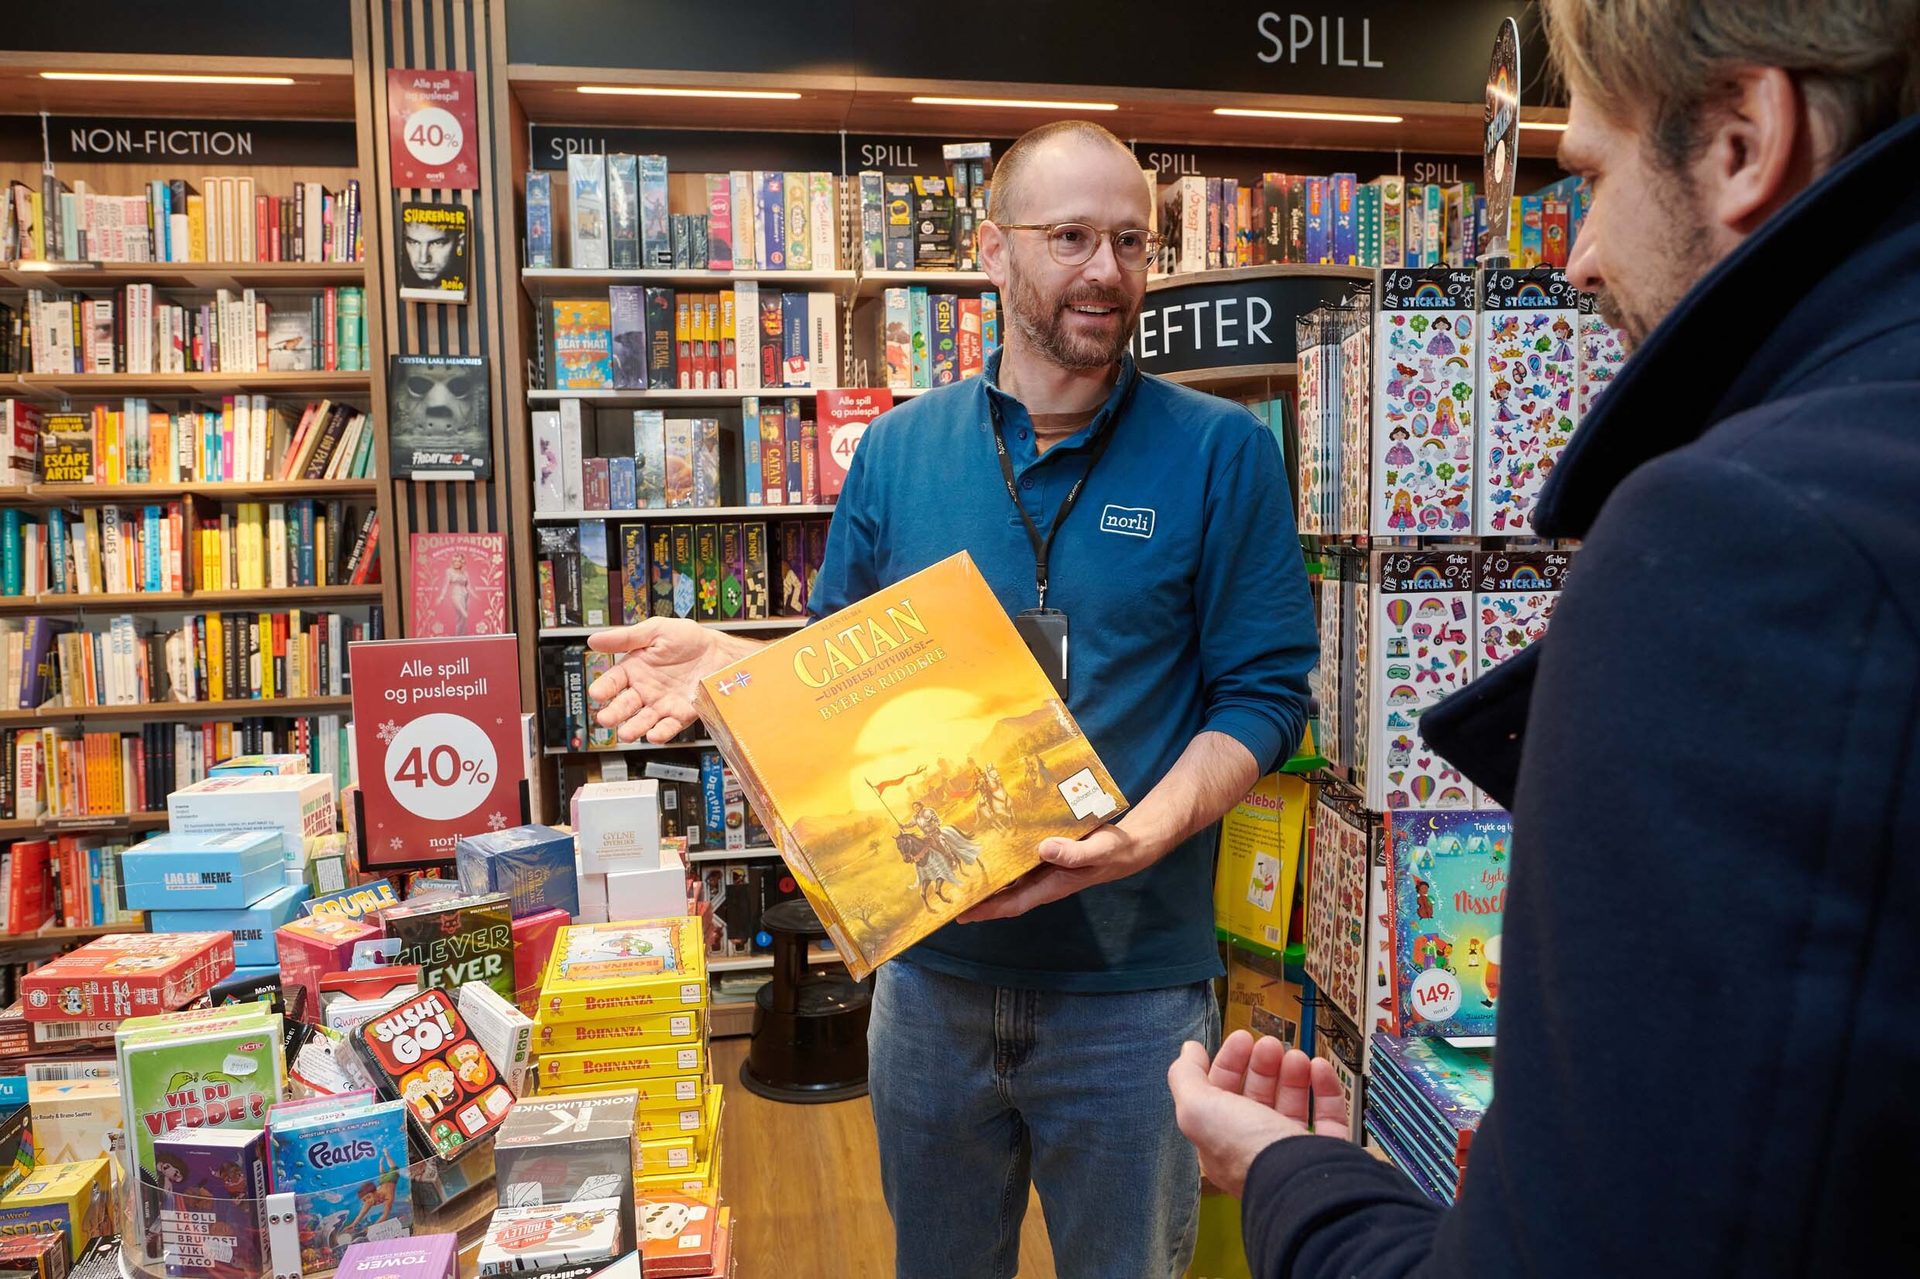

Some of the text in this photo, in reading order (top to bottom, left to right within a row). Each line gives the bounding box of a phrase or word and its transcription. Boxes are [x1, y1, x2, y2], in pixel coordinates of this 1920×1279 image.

[1257, 11, 1384, 68] SPILL
[413, 79, 450, 90] Alle spill
[420, 91, 459, 102] puslespill
[71, 129, 253, 156] NON-FICTION
[409, 124, 460, 148] 40%
[861, 144, 918, 167] SPILL
[1149, 153, 1201, 175] SPILL
[1413, 162, 1462, 183] SPILL
[403, 208, 466, 224] SURRENDER
[441, 279, 464, 290] BONO
[1550, 272, 1568, 282] Tink
[1402, 296, 1456, 308] STICKERS
[1505, 296, 1558, 308] STICKERS
[938, 301, 950, 333] GENI
[1130, 297, 1273, 360] EFTER
[558, 337, 608, 350] BEAT THAT!
[398, 356, 483, 366] CRYSTAL LAKE MEMORIES
[839, 395, 872, 407] Alle spill
[831, 406, 880, 419] og puslespill
[791, 440, 799, 463] CATAN
[44, 453, 90, 468] ESCAPE
[768, 448, 781, 485] CATAN
[45, 467, 89, 480] ARTIST
[1106, 514, 1148, 531] norli
[104, 509, 117, 555] ROGUES
[417, 536, 502, 552] DOLLY PARTON
[626, 534, 635, 549] 100
[676, 537, 685, 561] BINGO
[700, 537, 709, 561] BINGO
[748, 532, 757, 561] RUMMY
[1401, 578, 1453, 590] STICKERS
[1499, 578, 1552, 590] STICKERS
[793, 599, 929, 689] CATAN
[225, 658, 233, 688] STEWART
[239, 657, 247, 688] STEWART
[400, 657, 470, 678] Alle spill
[823, 640, 927, 699] UDVIDELSE/UTVIDELSE
[384, 678, 488, 704] og puslespill
[819, 647, 947, 720] BYER & RIDDERE
[570, 673, 582, 715] COLD CASES
[20, 747, 33, 788] FREEDOM
[393, 744, 490, 788] 40%
[322, 792, 331, 806] YOU
[706, 776, 721, 829] DECIPHER
[602, 831, 635, 840] GYLNE
[1474, 823, 1506, 834] Trykk og
[429, 834, 463, 848] norli
[186, 872, 199, 884] EN
[201, 871, 232, 884] MEME
[232, 929, 262, 940] MEME
[393, 924, 510, 967] CLEVER
[423, 953, 503, 988] EVER
[254, 984, 276, 995] MoYu
[585, 995, 654, 1010] BOHNANZA
[392, 1011, 455, 1065] GO!
[575, 1026, 644, 1041] BOHNANZA
[238, 1042, 263, 1051] TACTIC
[582, 1059, 651, 1074] BOHNANZA
[166, 1083, 230, 1108] VIL DU
[511, 1096, 635, 1113] KOKKELIMONKE
[543, 1107, 593, 1135] K
[6, 1211, 31, 1220] Wrede
[175, 1212, 215, 1222] TROLL
[176, 1224, 208, 1233] LAKS
[502, 1221, 546, 1240] TROLLEY
[179, 1257, 212, 1266] TACO
[356, 1256, 427, 1271] TOWER
